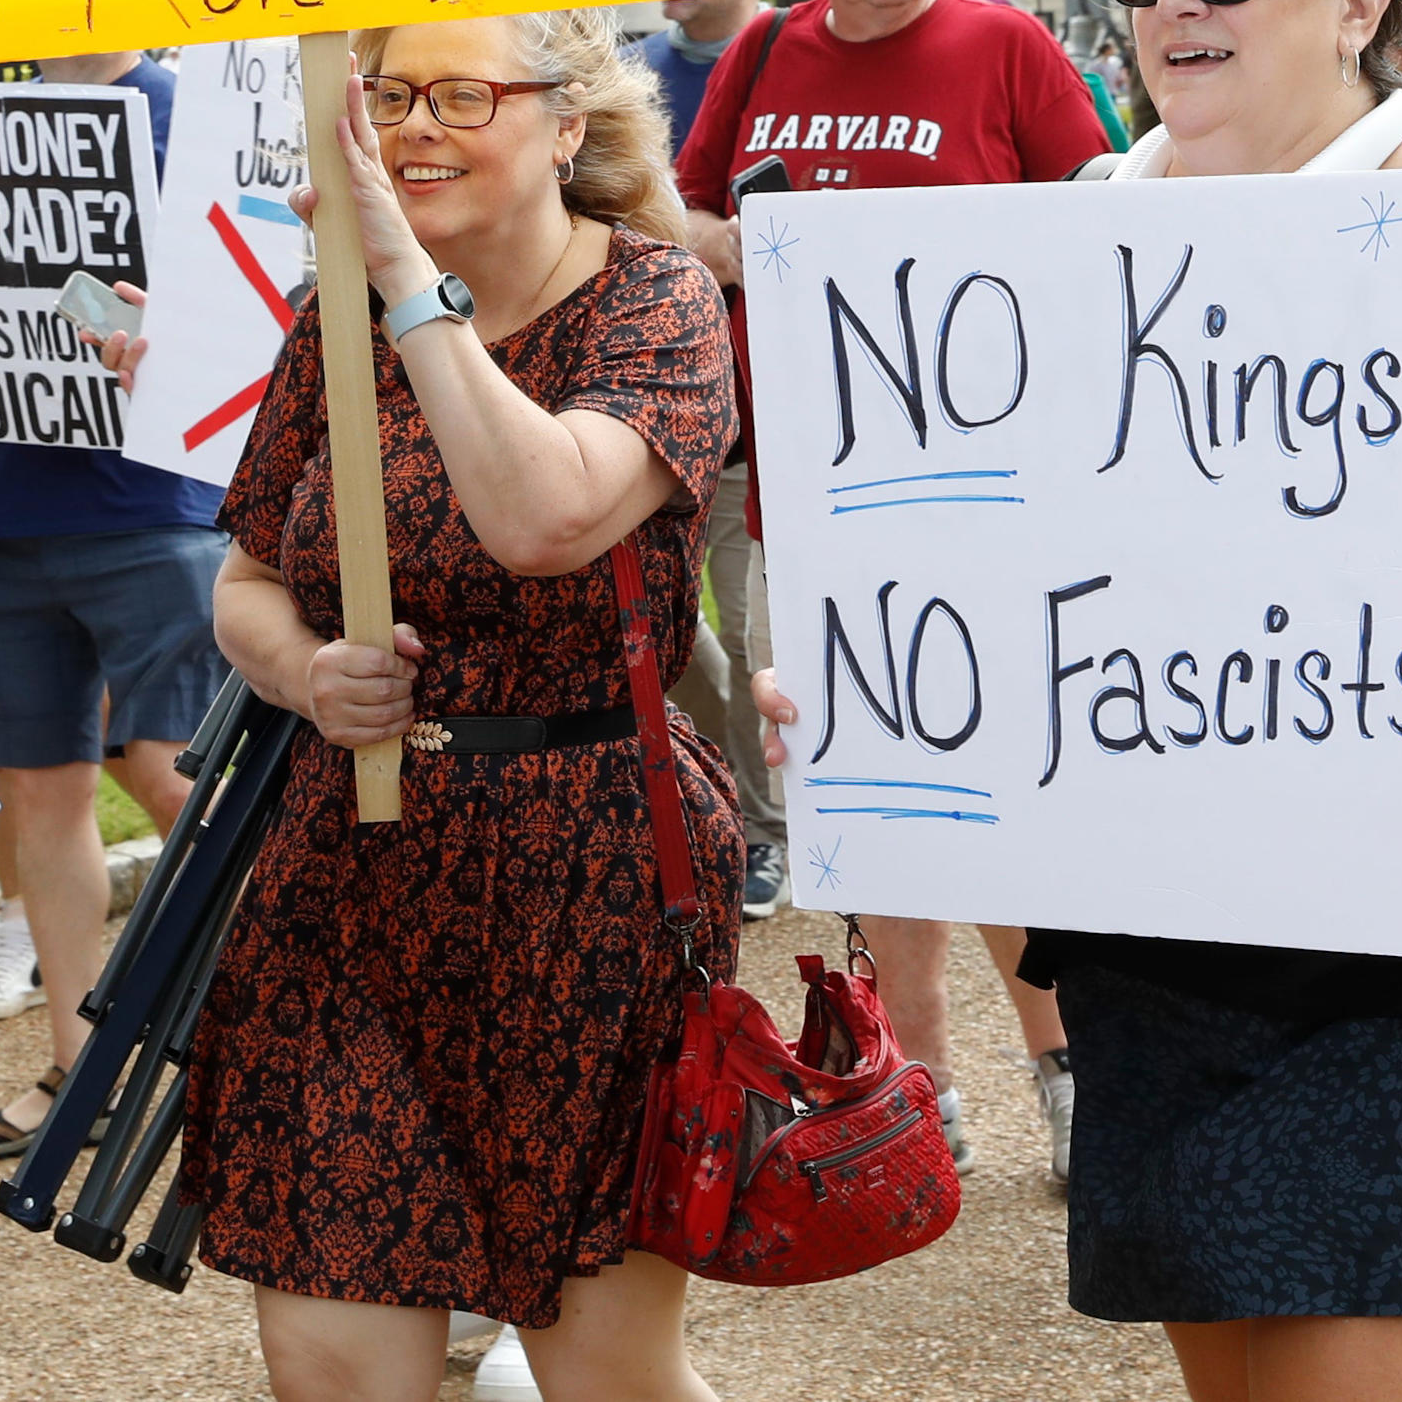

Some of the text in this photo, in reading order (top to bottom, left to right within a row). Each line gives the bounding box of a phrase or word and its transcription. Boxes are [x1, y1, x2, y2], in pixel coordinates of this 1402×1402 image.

[222, 41, 266, 94] No
[745, 113, 942, 157] HARVARD
[824, 257, 1028, 467] NO
[810, 579, 984, 765] NO
